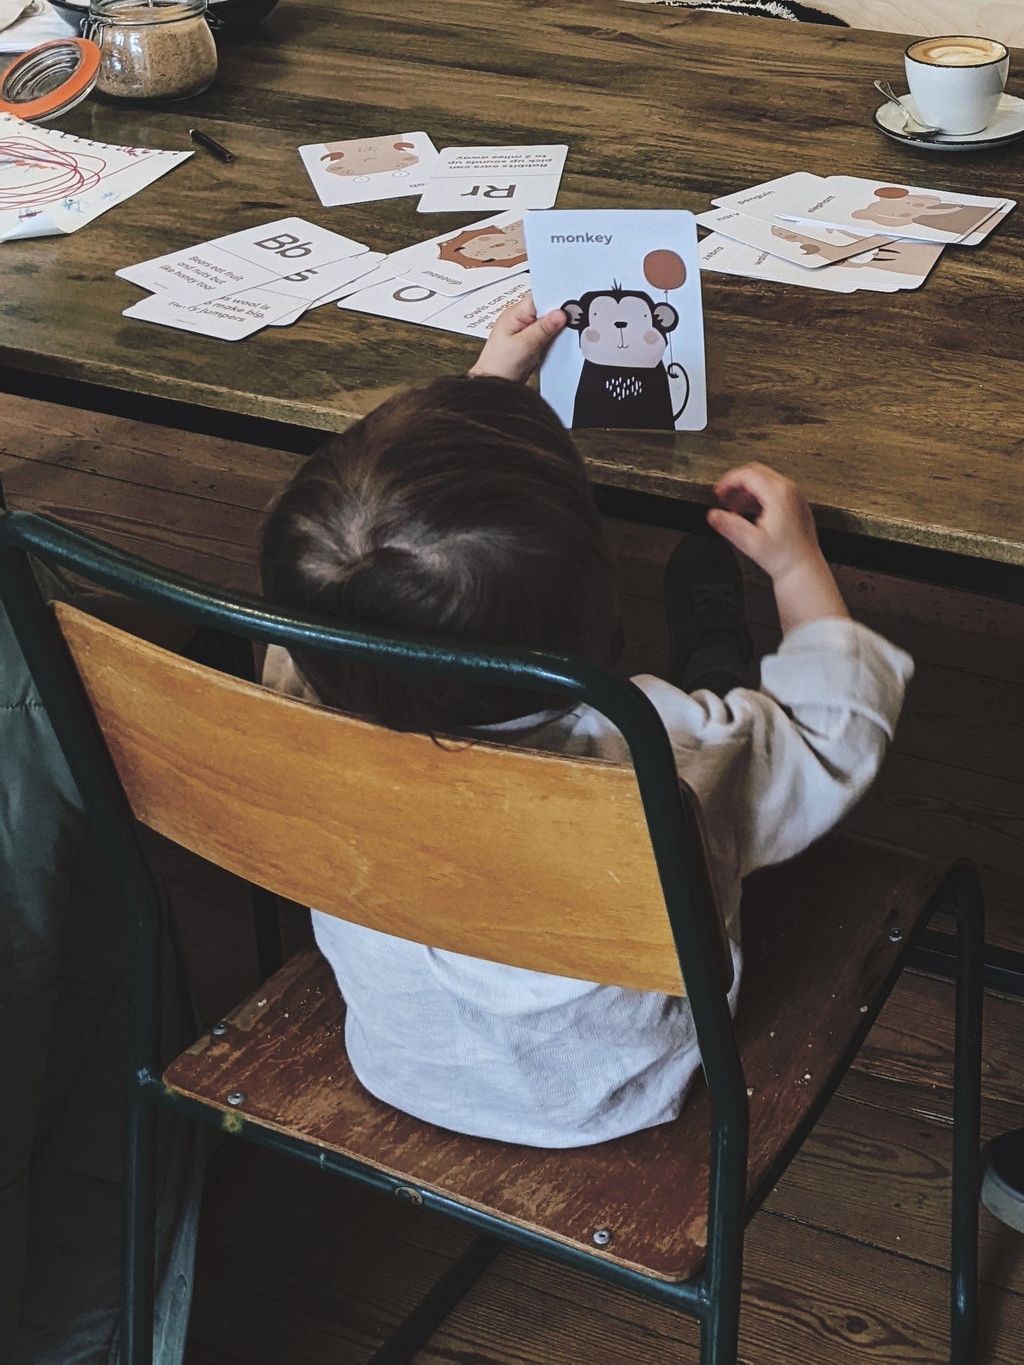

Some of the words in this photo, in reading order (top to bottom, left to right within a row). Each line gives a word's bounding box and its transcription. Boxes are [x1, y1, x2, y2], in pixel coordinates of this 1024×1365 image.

[460, 184, 517, 198] Rr
[253, 233, 313, 258] Bb
[551, 232, 613, 245] monkey
[177, 262, 196, 270] and
[192, 268, 212, 278] nuts
[209, 275, 227, 285] but
[189, 255, 213, 267] Bears
[210, 266, 227, 274] eat
[223, 271, 244, 281] fruit
[212, 302, 244, 313] make
[232, 298, 261, 308] wool
[464, 305, 489, 319] Owls
[488, 294, 507, 305] can
[197, 308, 247, 322] jumpers
